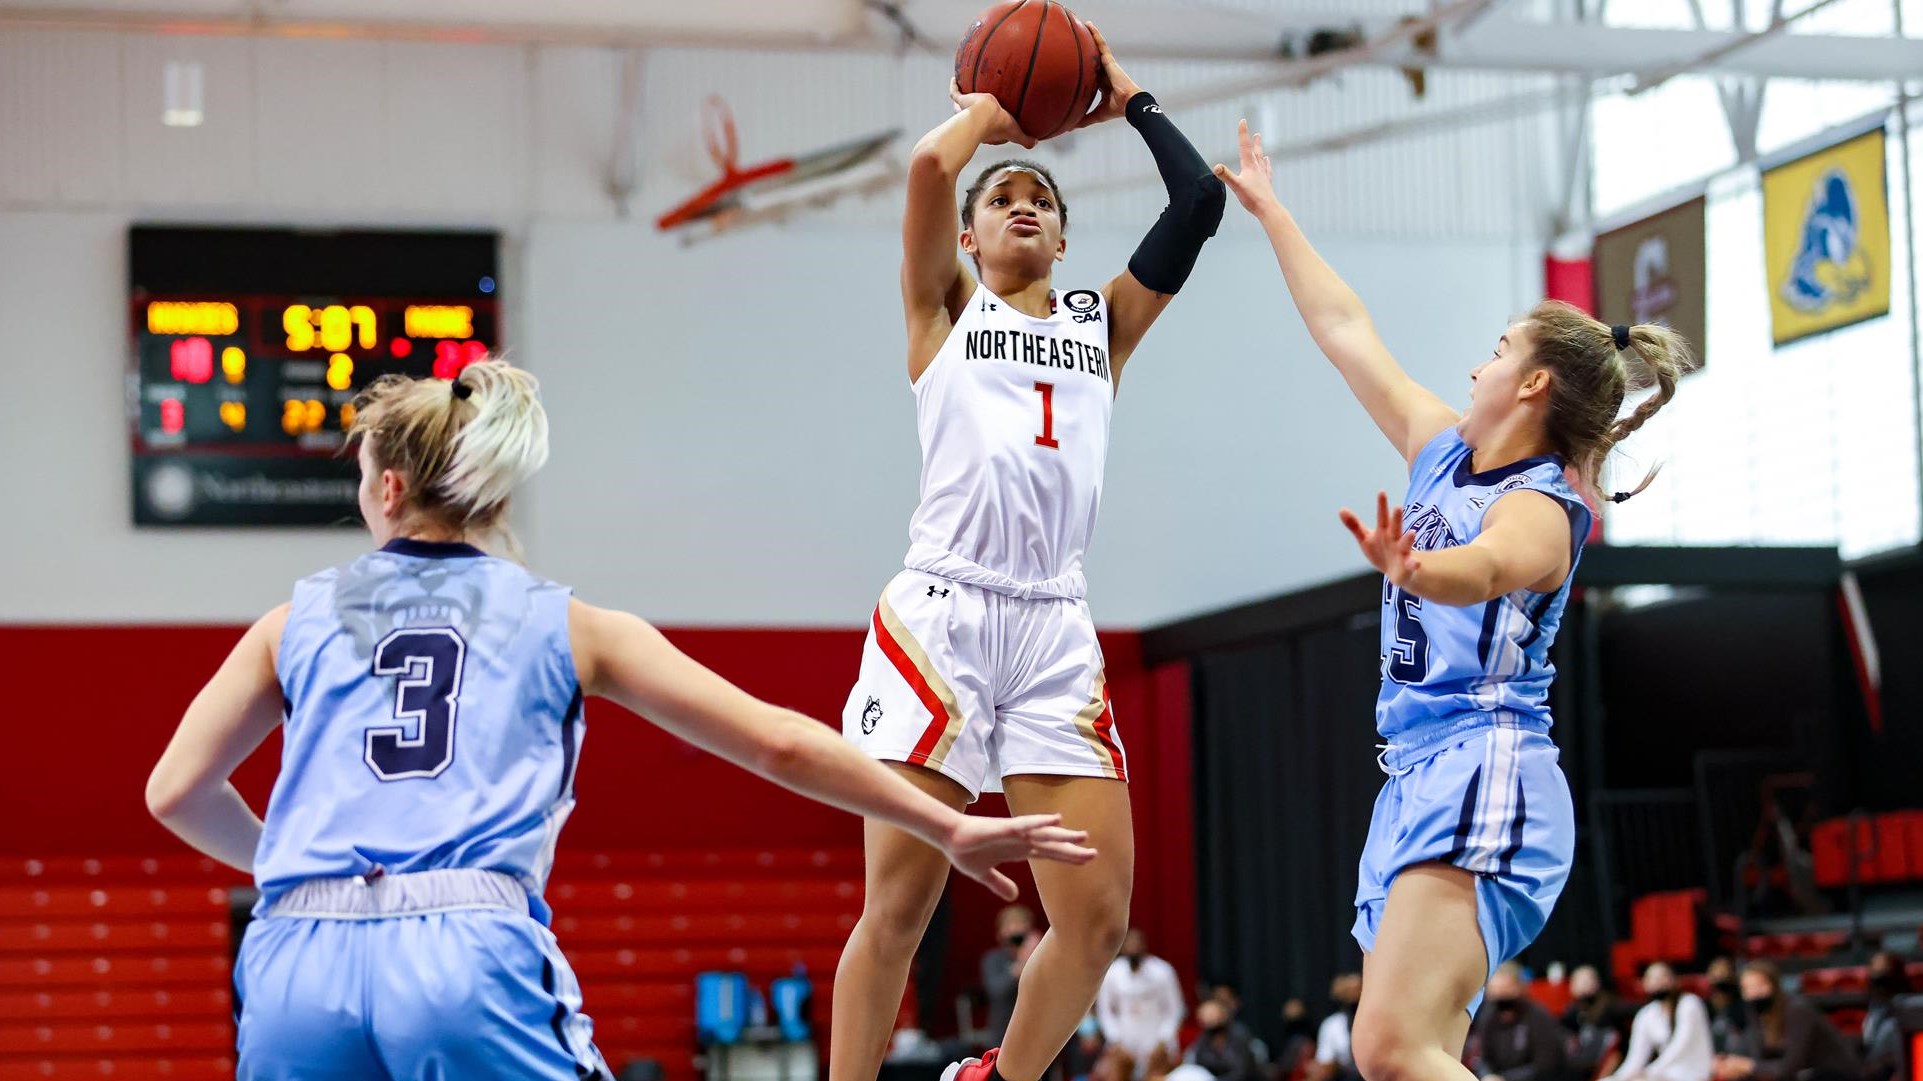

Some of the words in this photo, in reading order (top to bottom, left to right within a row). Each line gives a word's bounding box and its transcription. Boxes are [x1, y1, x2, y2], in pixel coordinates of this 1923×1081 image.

[1072, 310, 1102, 323] CAA
[966, 329, 1109, 382] NORTHEASTERN
[1033, 380, 1059, 450] 1
[1381, 577, 1430, 685] 5
[363, 626, 467, 782] 3
